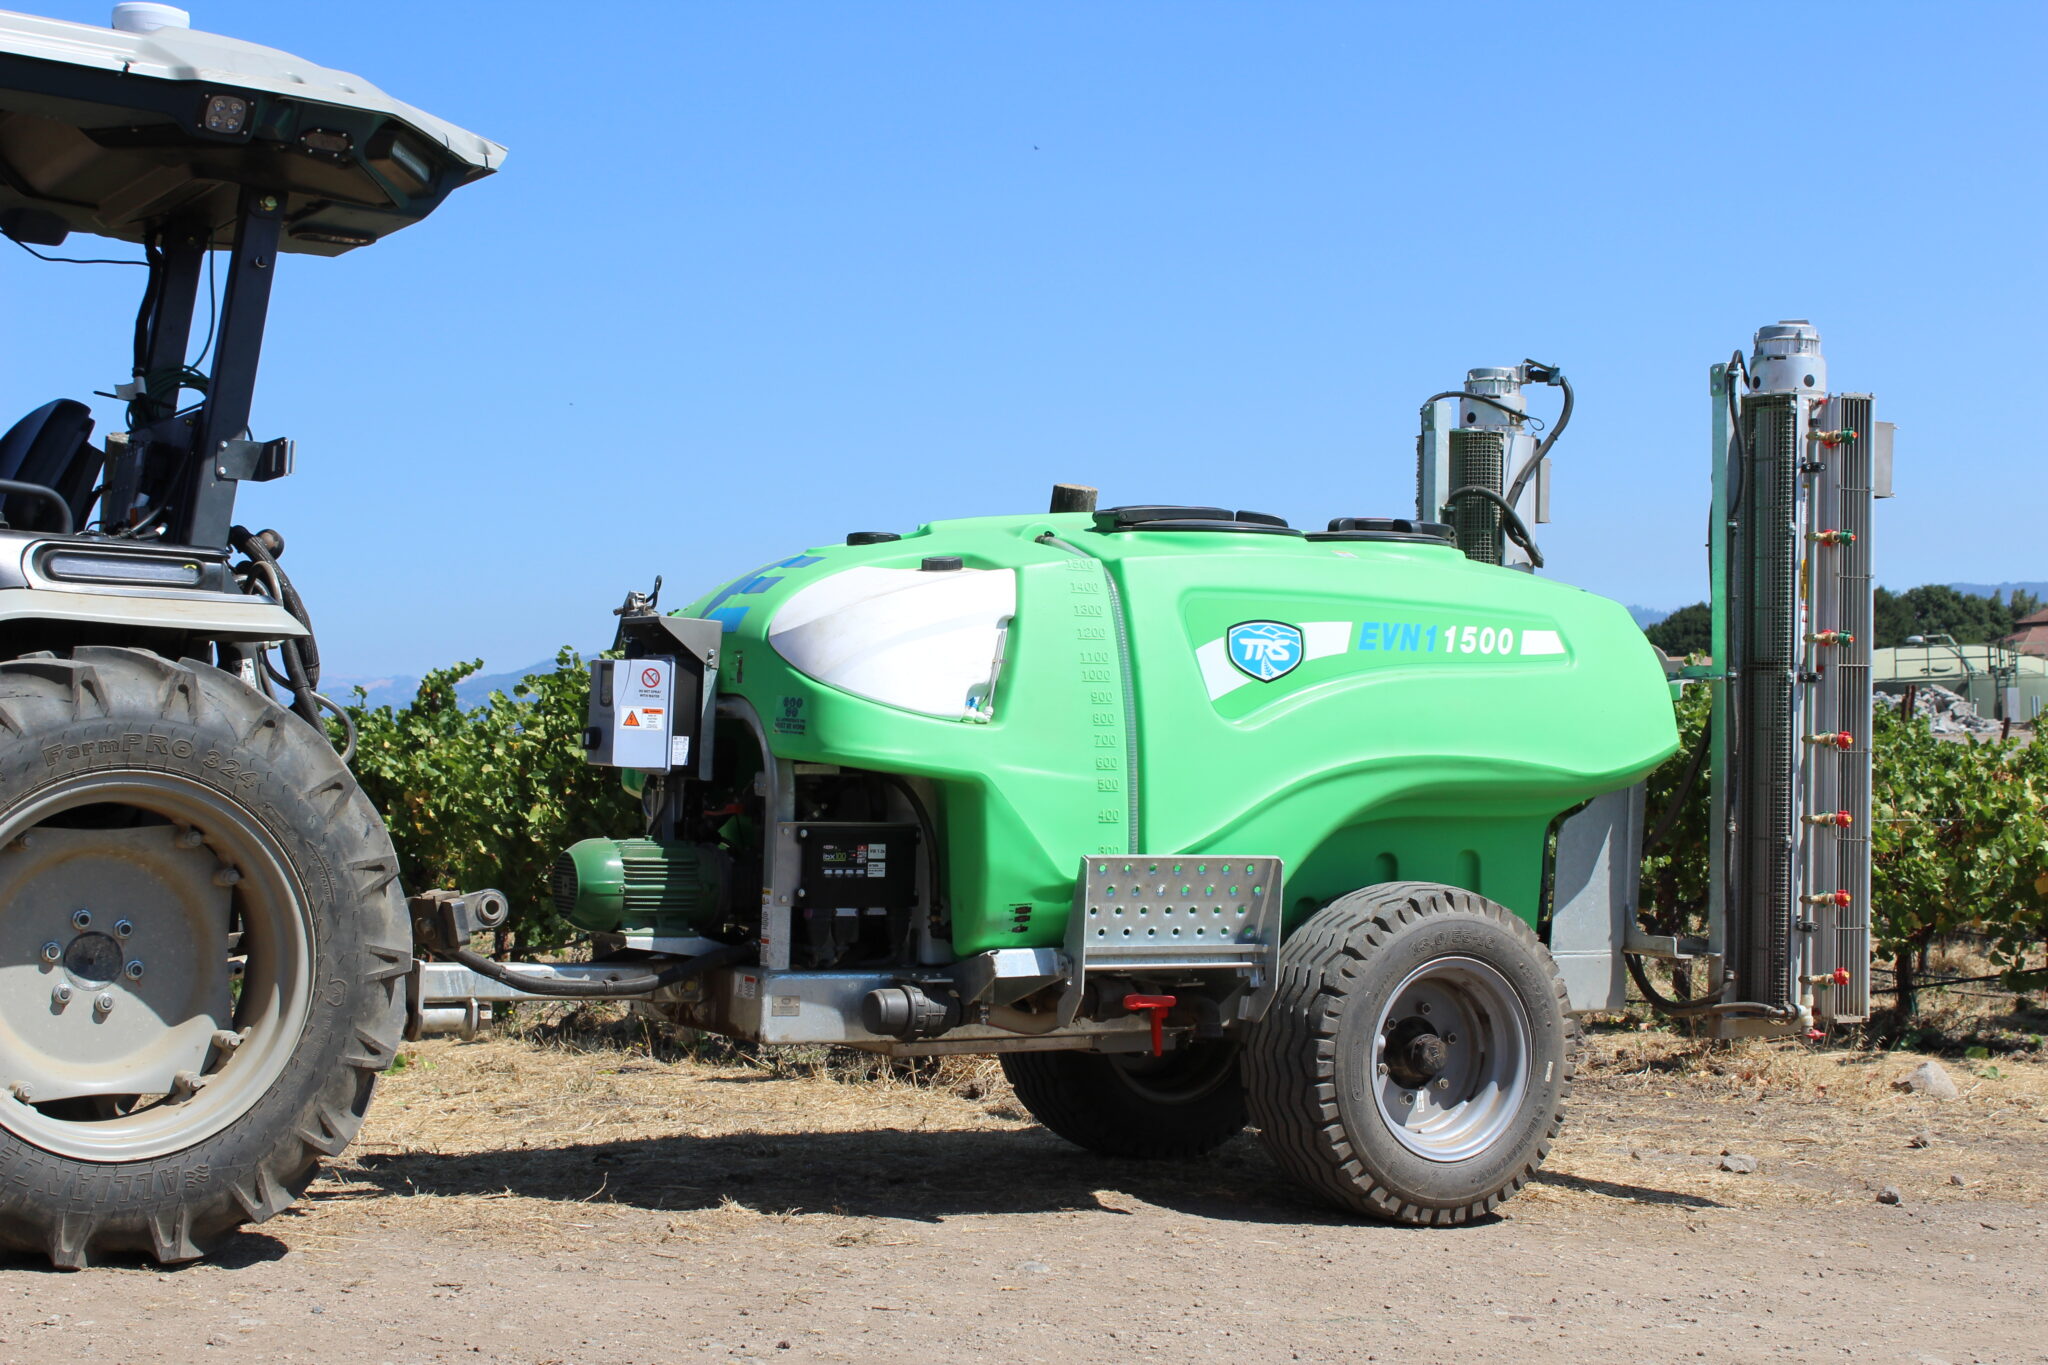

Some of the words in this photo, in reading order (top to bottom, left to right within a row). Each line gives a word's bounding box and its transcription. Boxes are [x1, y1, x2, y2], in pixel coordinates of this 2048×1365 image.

[1065, 558, 1094, 570] 1500
[1070, 581, 1099, 592] 1400
[1074, 604, 1102, 615] 1300
[1077, 627, 1105, 638] 1200
[1358, 622, 1438, 652] EVN1
[1444, 626, 1514, 655] 1500
[1239, 638, 1291, 661] TRS
[1080, 651, 1109, 663] 1100
[1081, 669, 1111, 681] 1000
[1091, 691, 1113, 702] 900
[1093, 713, 1115, 724] 800
[1094, 734, 1116, 746] 700
[42, 733, 193, 767] FarmPRO
[202, 749, 259, 789] 324
[1096, 757, 1118, 769] 600
[1098, 779, 1119, 790] 500
[1098, 810, 1119, 822] 400
